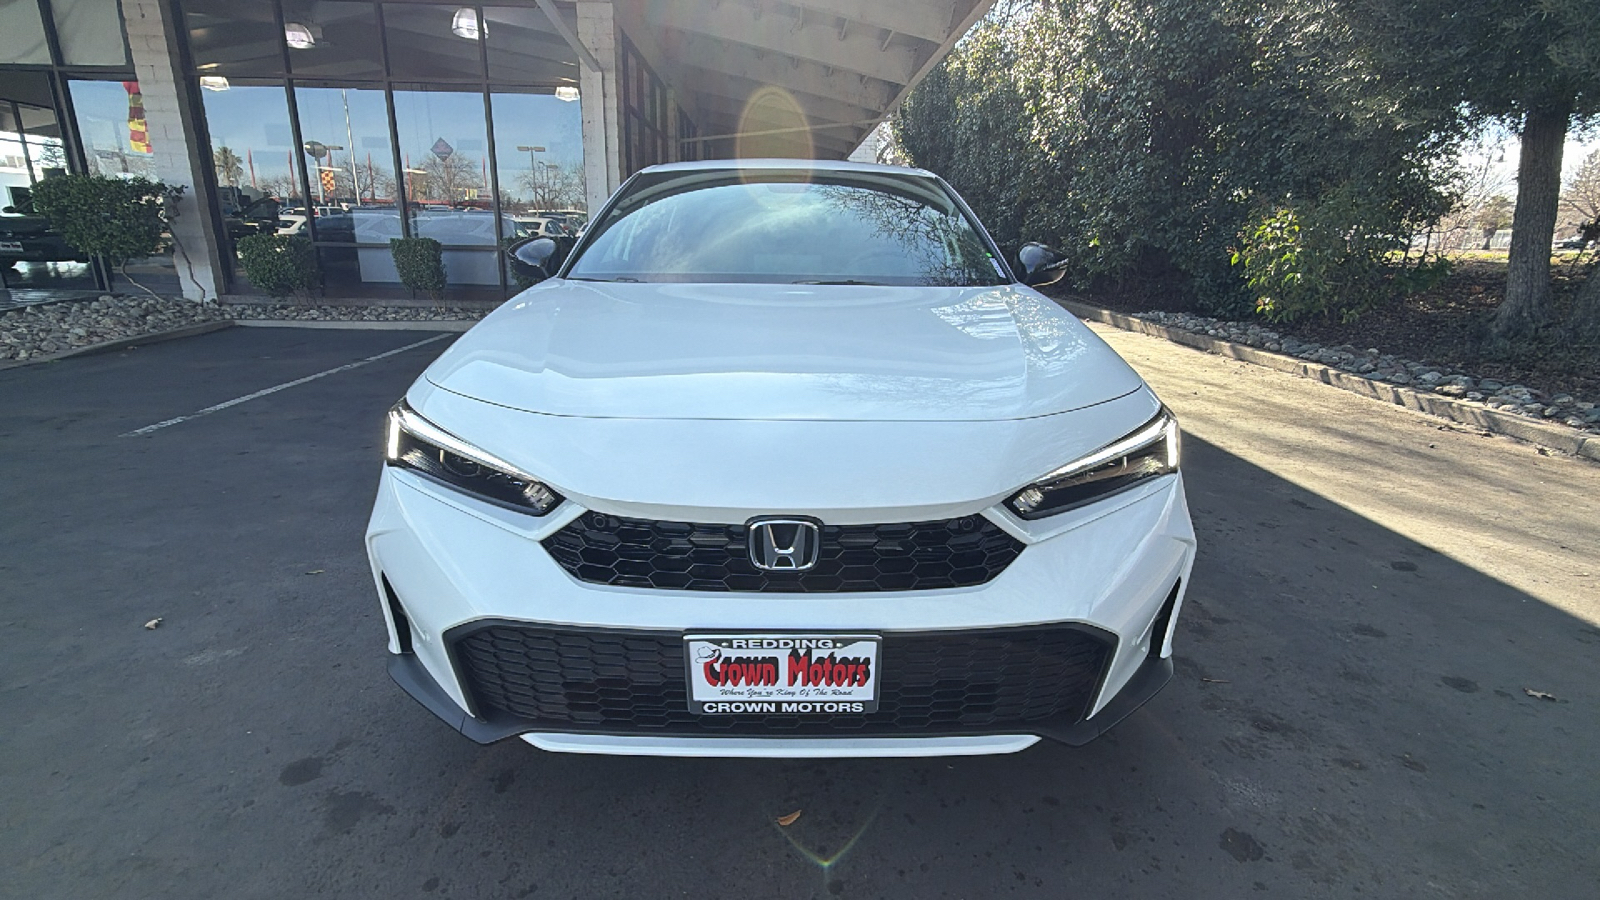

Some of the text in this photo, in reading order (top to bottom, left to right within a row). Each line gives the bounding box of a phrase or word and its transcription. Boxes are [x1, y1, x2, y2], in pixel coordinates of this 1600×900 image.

[732, 639, 834, 649] REDDING
[703, 649, 870, 687] Crown Motors
[720, 688, 745, 696] Where
[776, 688, 796, 697] King
[799, 688, 810, 697] Of
[813, 688, 828, 696] The
[831, 688, 853, 696] Road
[703, 702, 864, 713] CROWN MOTORS
